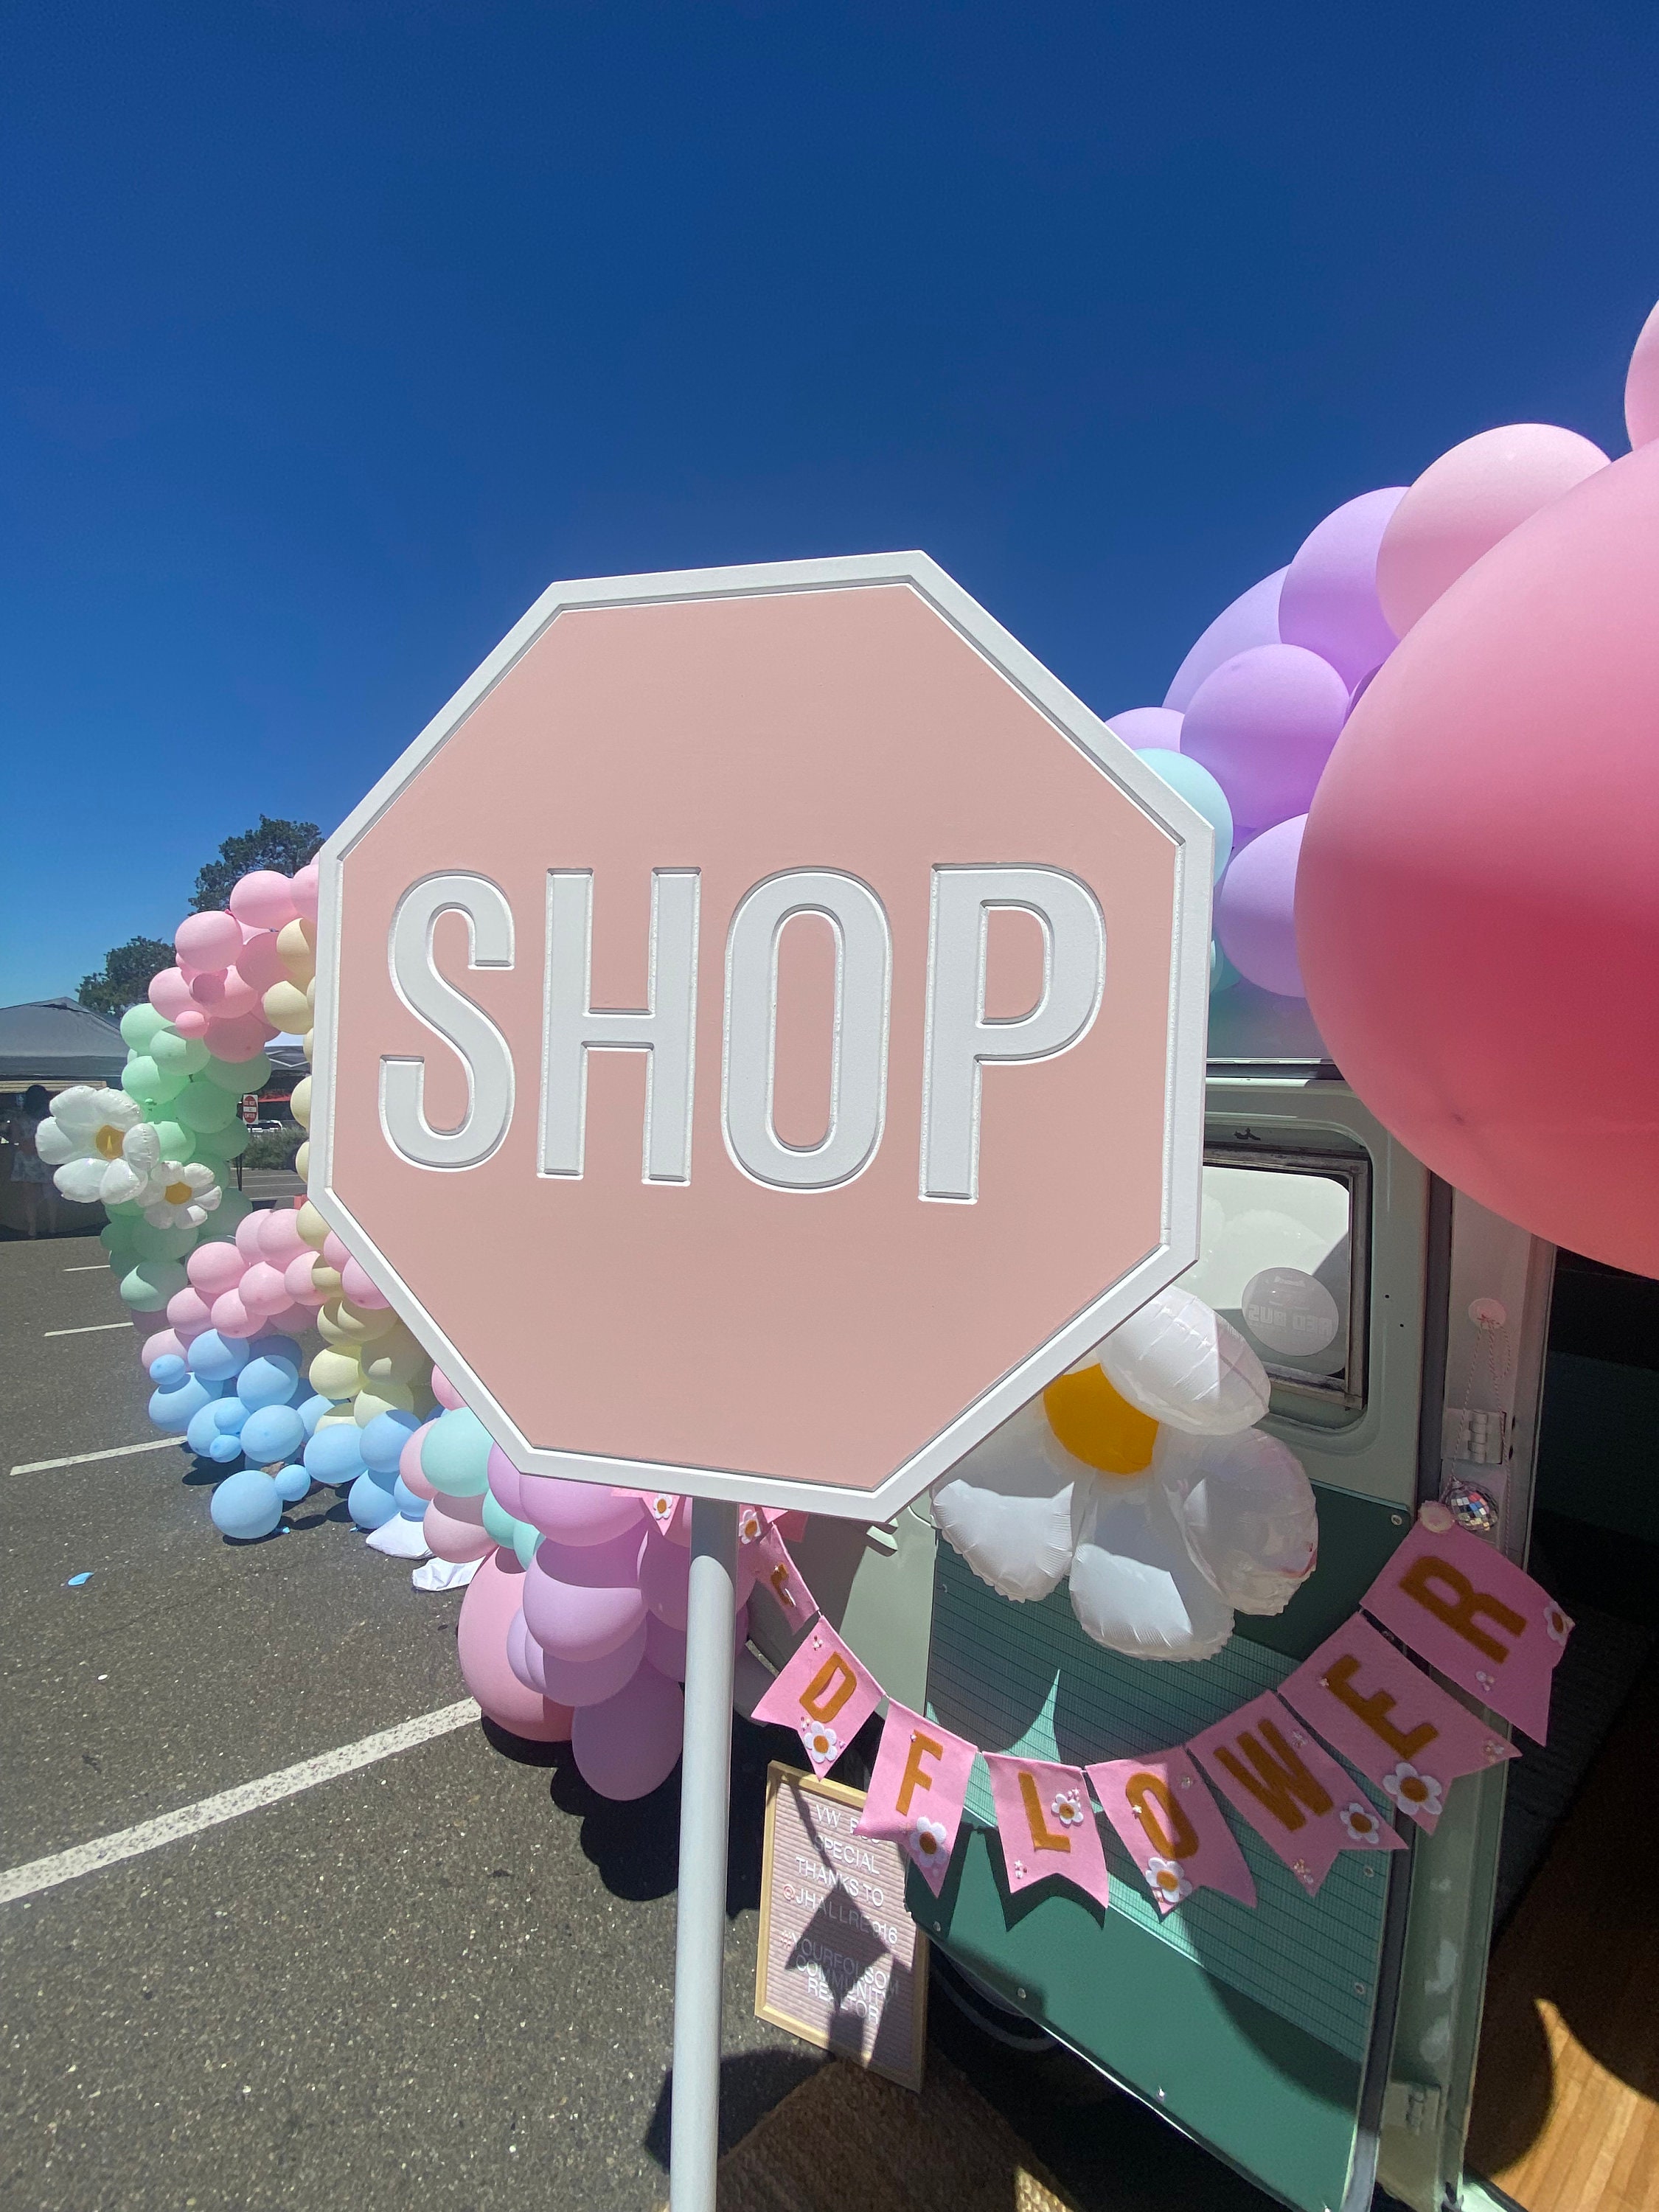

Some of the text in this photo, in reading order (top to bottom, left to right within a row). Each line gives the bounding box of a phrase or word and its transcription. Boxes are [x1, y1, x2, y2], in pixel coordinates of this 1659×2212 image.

[378, 862, 1106, 1205] SHOP
[815, 1804, 841, 1829] VW
[814, 1833, 880, 1875] SPECIAL
[796, 1856, 884, 1907] THANKS TO
